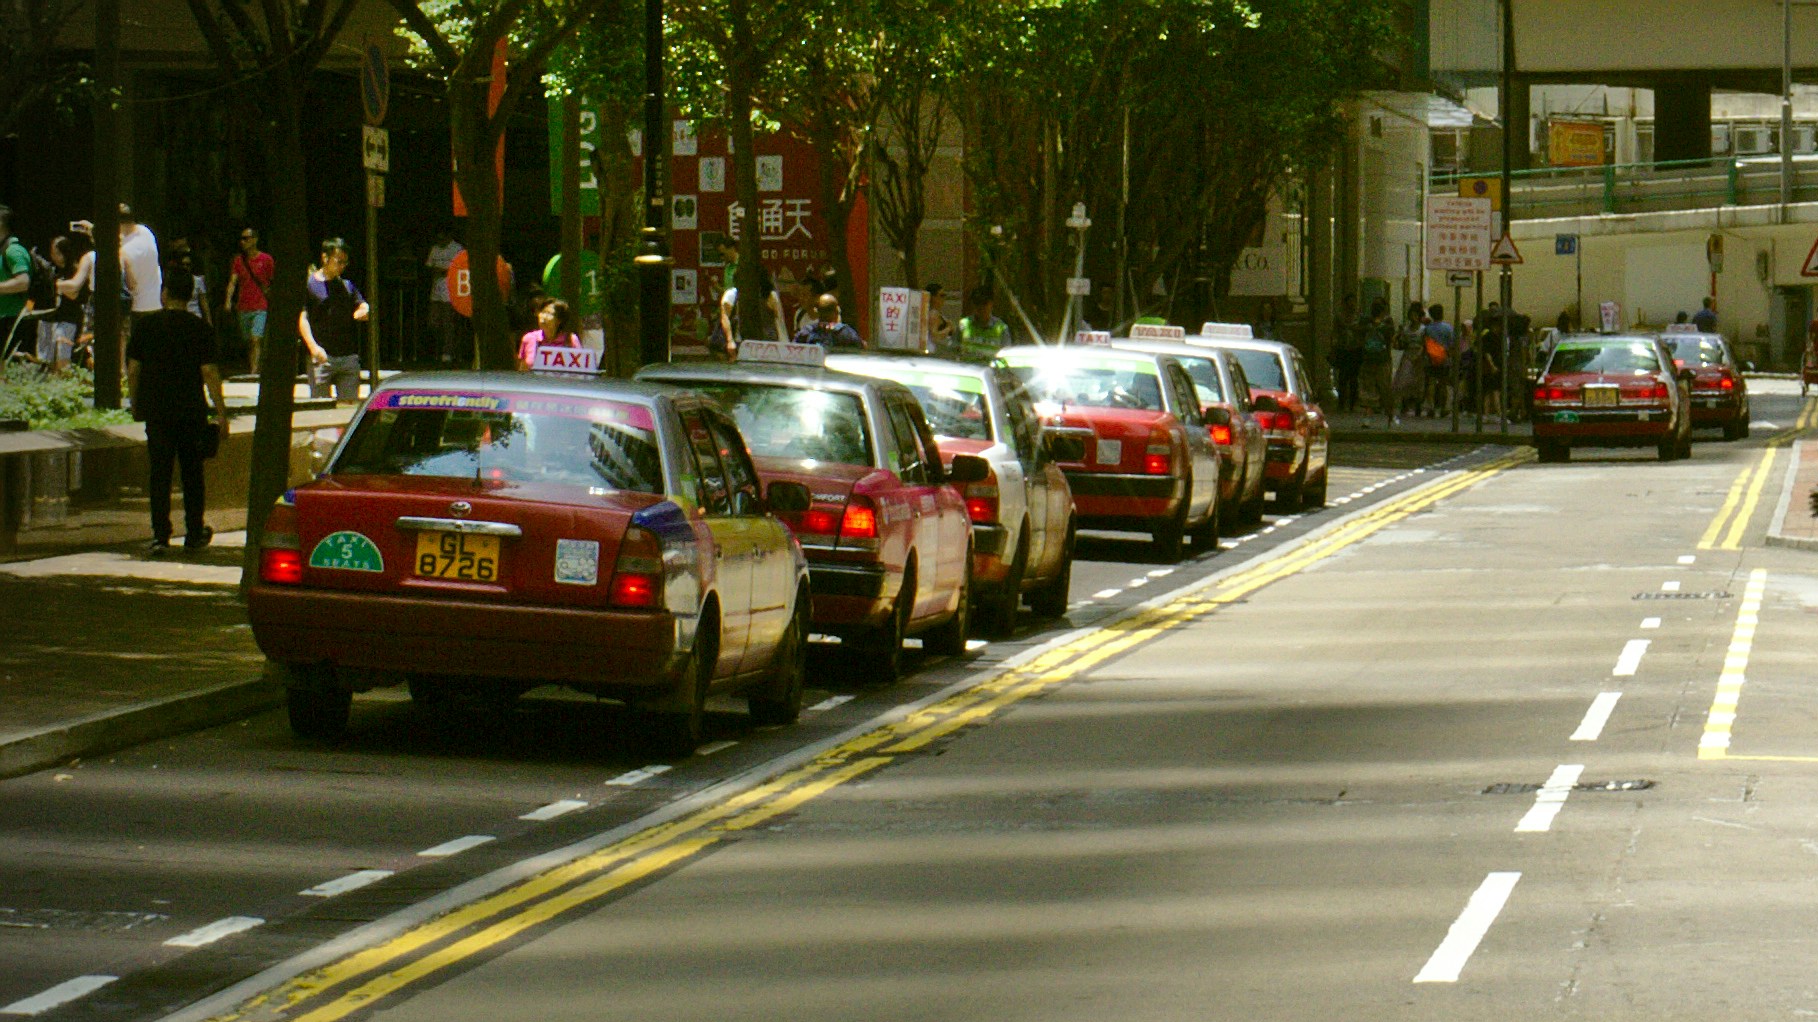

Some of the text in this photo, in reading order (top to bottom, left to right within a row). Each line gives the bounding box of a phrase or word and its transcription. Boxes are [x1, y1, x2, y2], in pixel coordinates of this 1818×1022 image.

[882, 292, 906, 302] TAXI
[1079, 333, 1108, 344] TAXI
[541, 350, 591, 369] TAXI
[399, 394, 500, 409] storefriendly
[325, 532, 368, 548] TAXI
[439, 533, 476, 558] GL
[341, 544, 352, 559] 5
[419, 554, 494, 581] 8726
